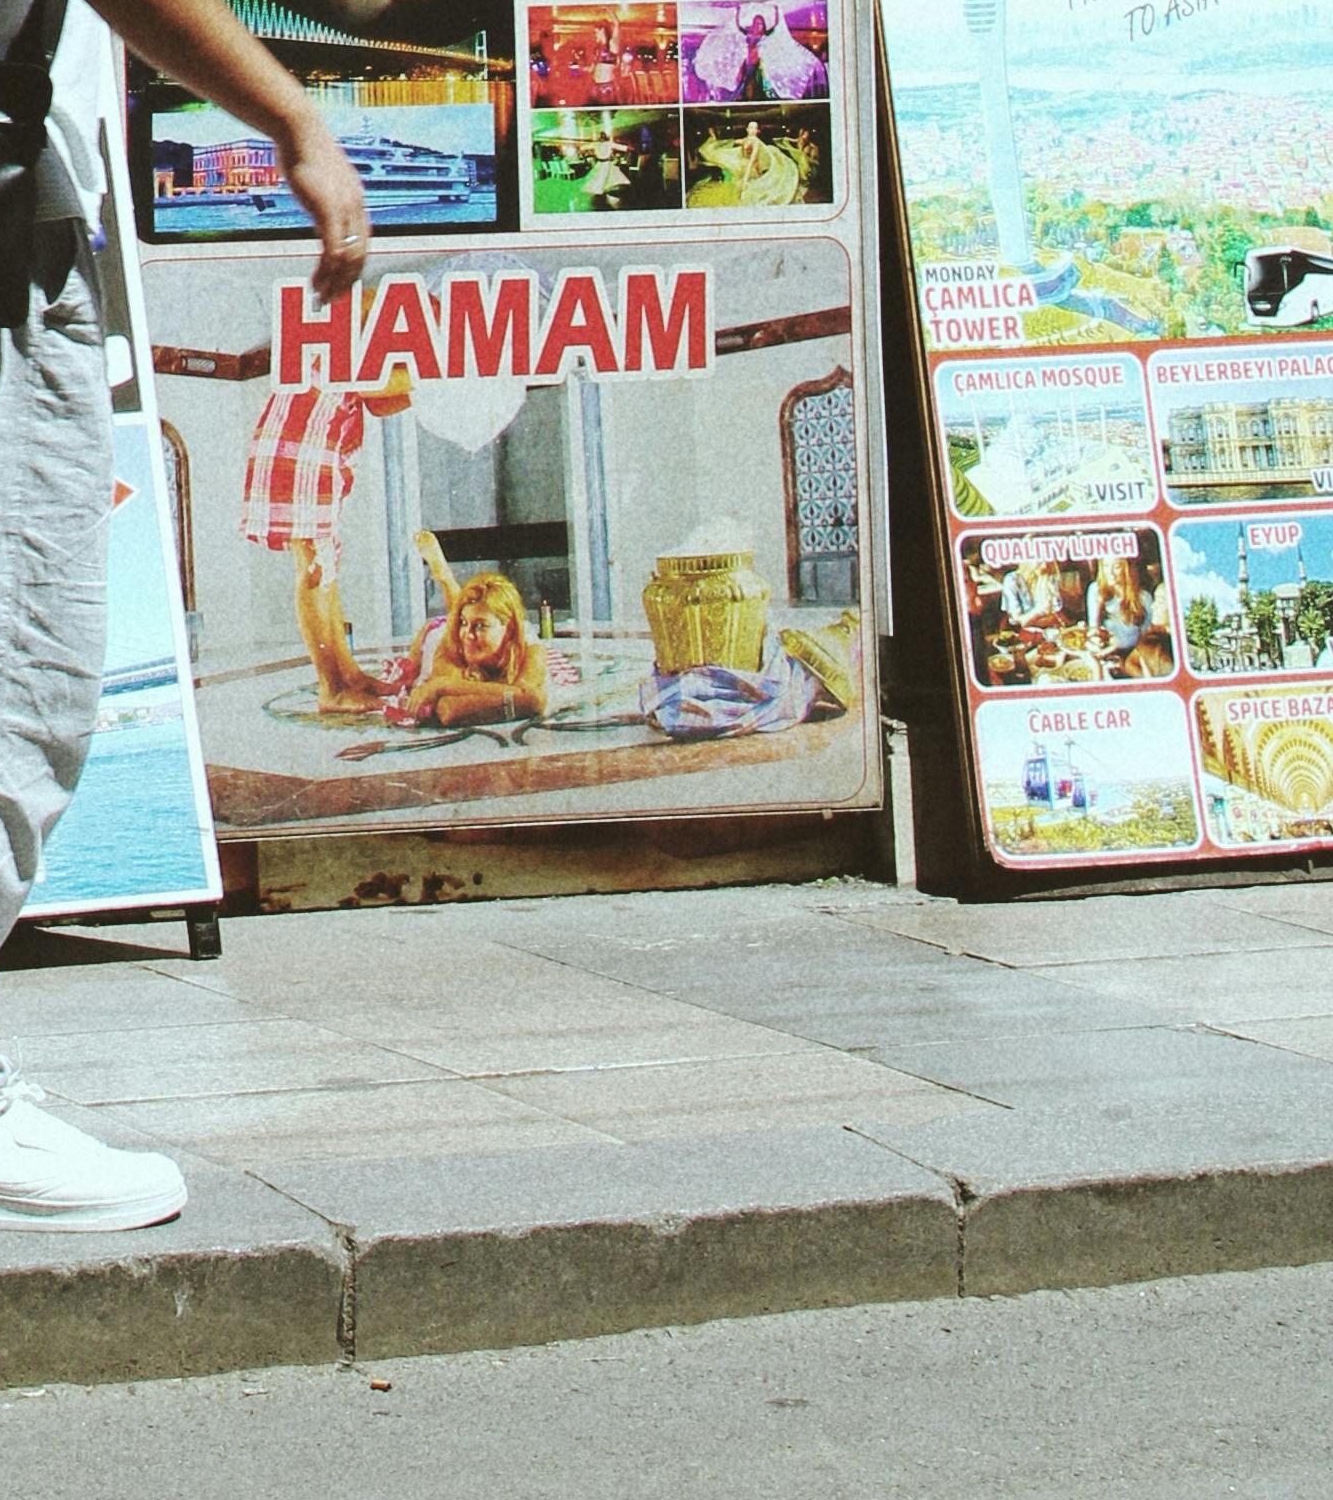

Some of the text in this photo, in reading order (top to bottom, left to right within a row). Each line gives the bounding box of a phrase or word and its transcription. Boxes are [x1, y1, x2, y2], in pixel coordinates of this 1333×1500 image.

[1125, 5, 1156, 41] TO
[278, 272, 707, 385] HAMAM
[929, 316, 1019, 343] TOWER
[1096, 482, 1145, 500] VISIT
[1249, 524, 1300, 545] EYUP
[985, 539, 1066, 562] QUALITY
